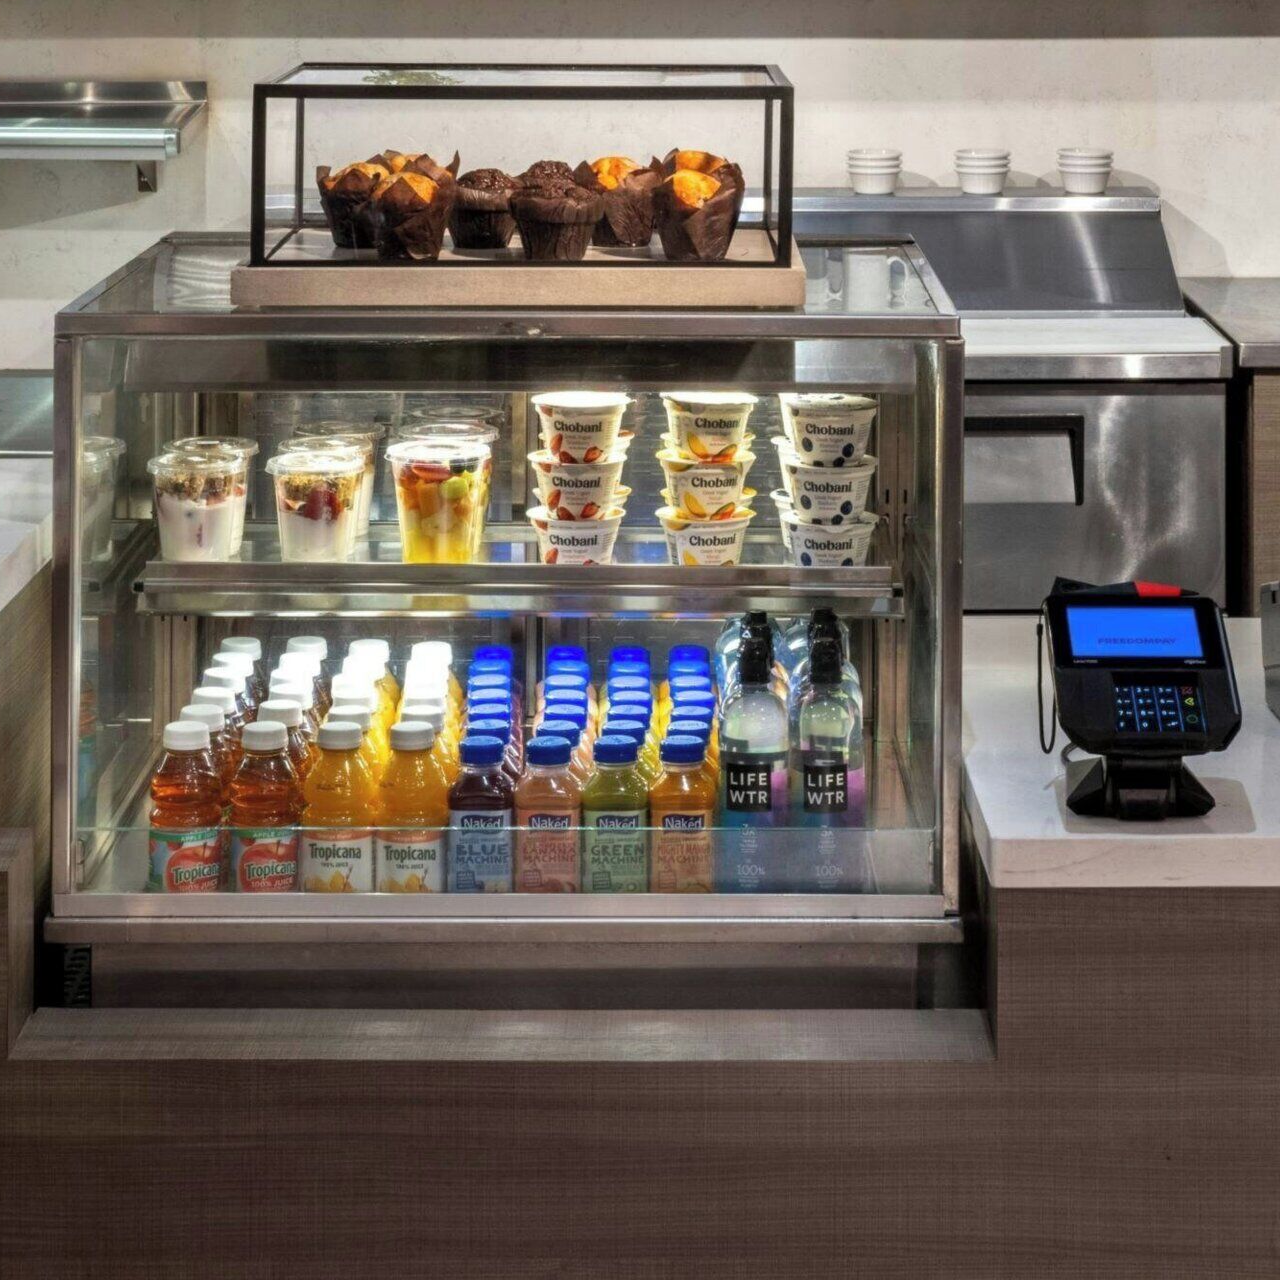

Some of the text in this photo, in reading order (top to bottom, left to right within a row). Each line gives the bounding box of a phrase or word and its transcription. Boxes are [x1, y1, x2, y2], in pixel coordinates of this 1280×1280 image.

[554, 420, 602, 434] Chobani
[805, 424, 854, 435] Chobani
[552, 476, 601, 489] Chobani
[691, 476, 738, 489] Chobani
[803, 481, 852, 493] Chobani
[549, 534, 598, 547] Chobani
[689, 533, 736, 546] Chobani
[804, 538, 853, 551] Chobani
[730, 772, 767, 786] LIFE
[807, 773, 844, 787] LIFE
[730, 790, 767, 804] WTR
[807, 791, 844, 805] WTR
[308, 842, 362, 860] Tropicana
[384, 845, 437, 861] Tropicana
[456, 844, 508, 856] BLUE
[591, 844, 645, 856] GREEN
